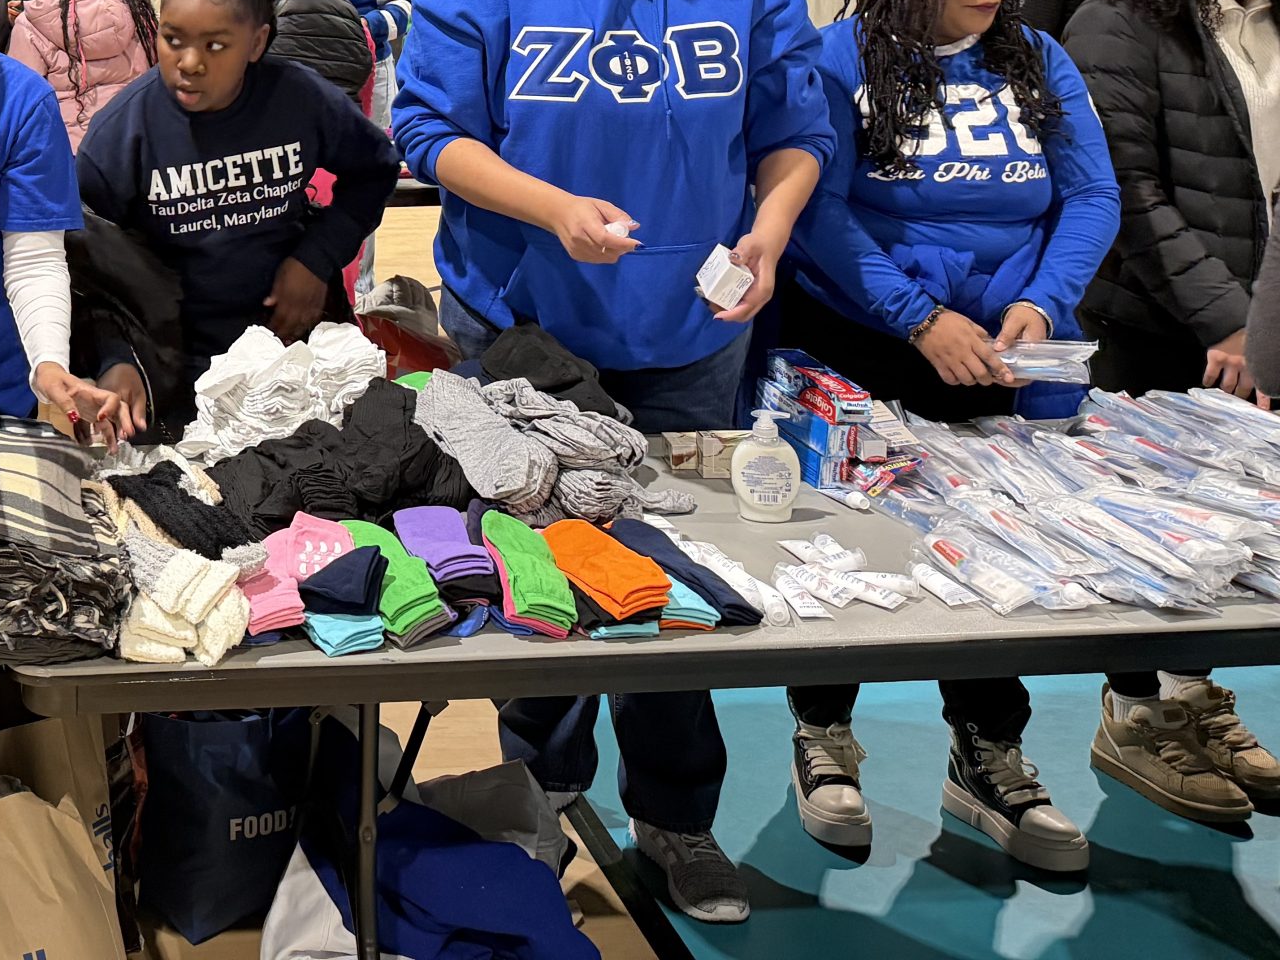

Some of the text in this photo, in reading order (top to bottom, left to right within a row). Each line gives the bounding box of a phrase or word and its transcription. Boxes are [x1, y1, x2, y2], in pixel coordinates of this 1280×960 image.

[147, 141, 304, 201] AMICETTE
[934, 161, 992, 183] Phi
[1001, 160, 1047, 183] Beta
[149, 177, 303, 216] Tau Delta Zeta Chapter
[170, 200, 289, 235] Laurel, Maryland
[805, 390, 833, 416] Colgate
